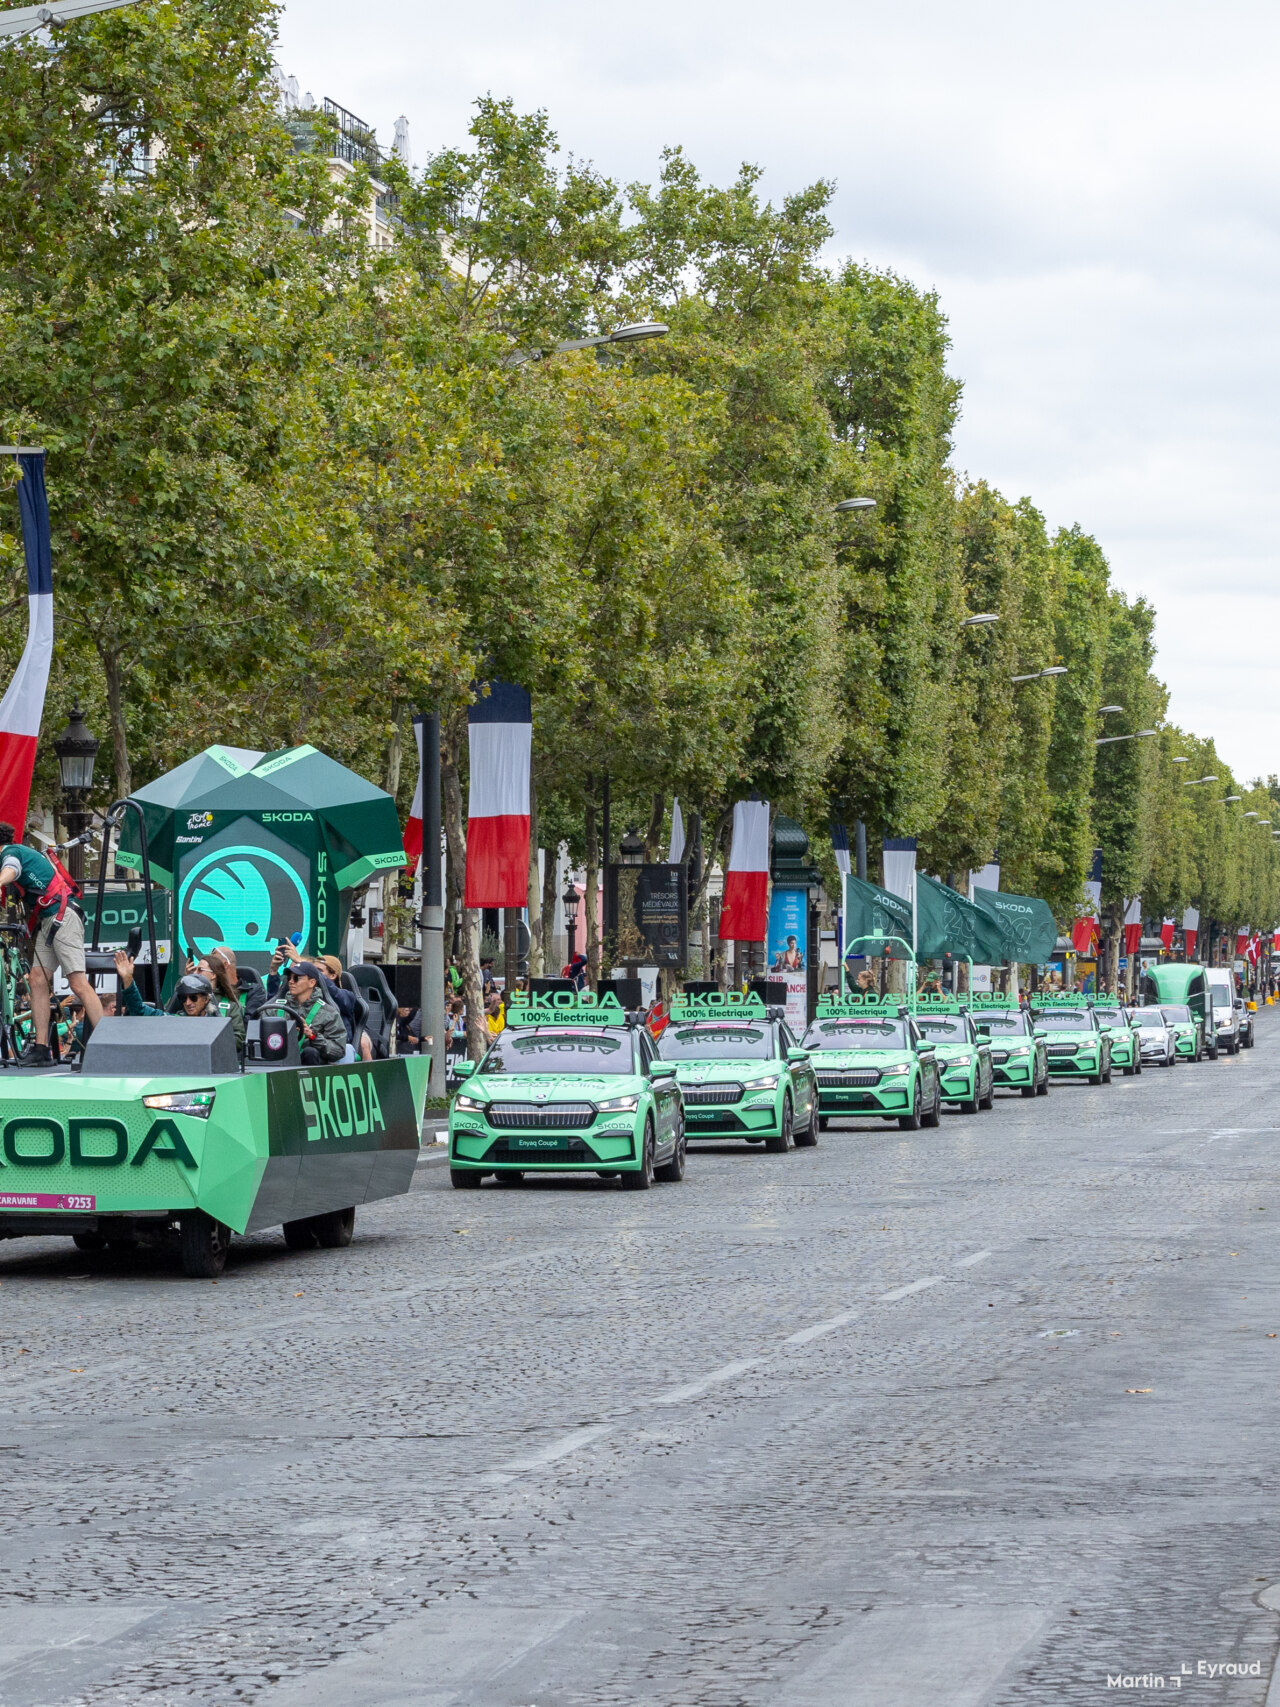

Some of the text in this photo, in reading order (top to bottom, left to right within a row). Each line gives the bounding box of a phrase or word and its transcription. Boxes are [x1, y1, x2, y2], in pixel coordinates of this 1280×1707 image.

[520, 1011, 609, 1024] 100% Électrique
[681, 1008, 754, 1019] 100% Électrique
[825, 1007, 888, 1018] 100% Électrique
[68, 1197, 91, 1208] 9253
